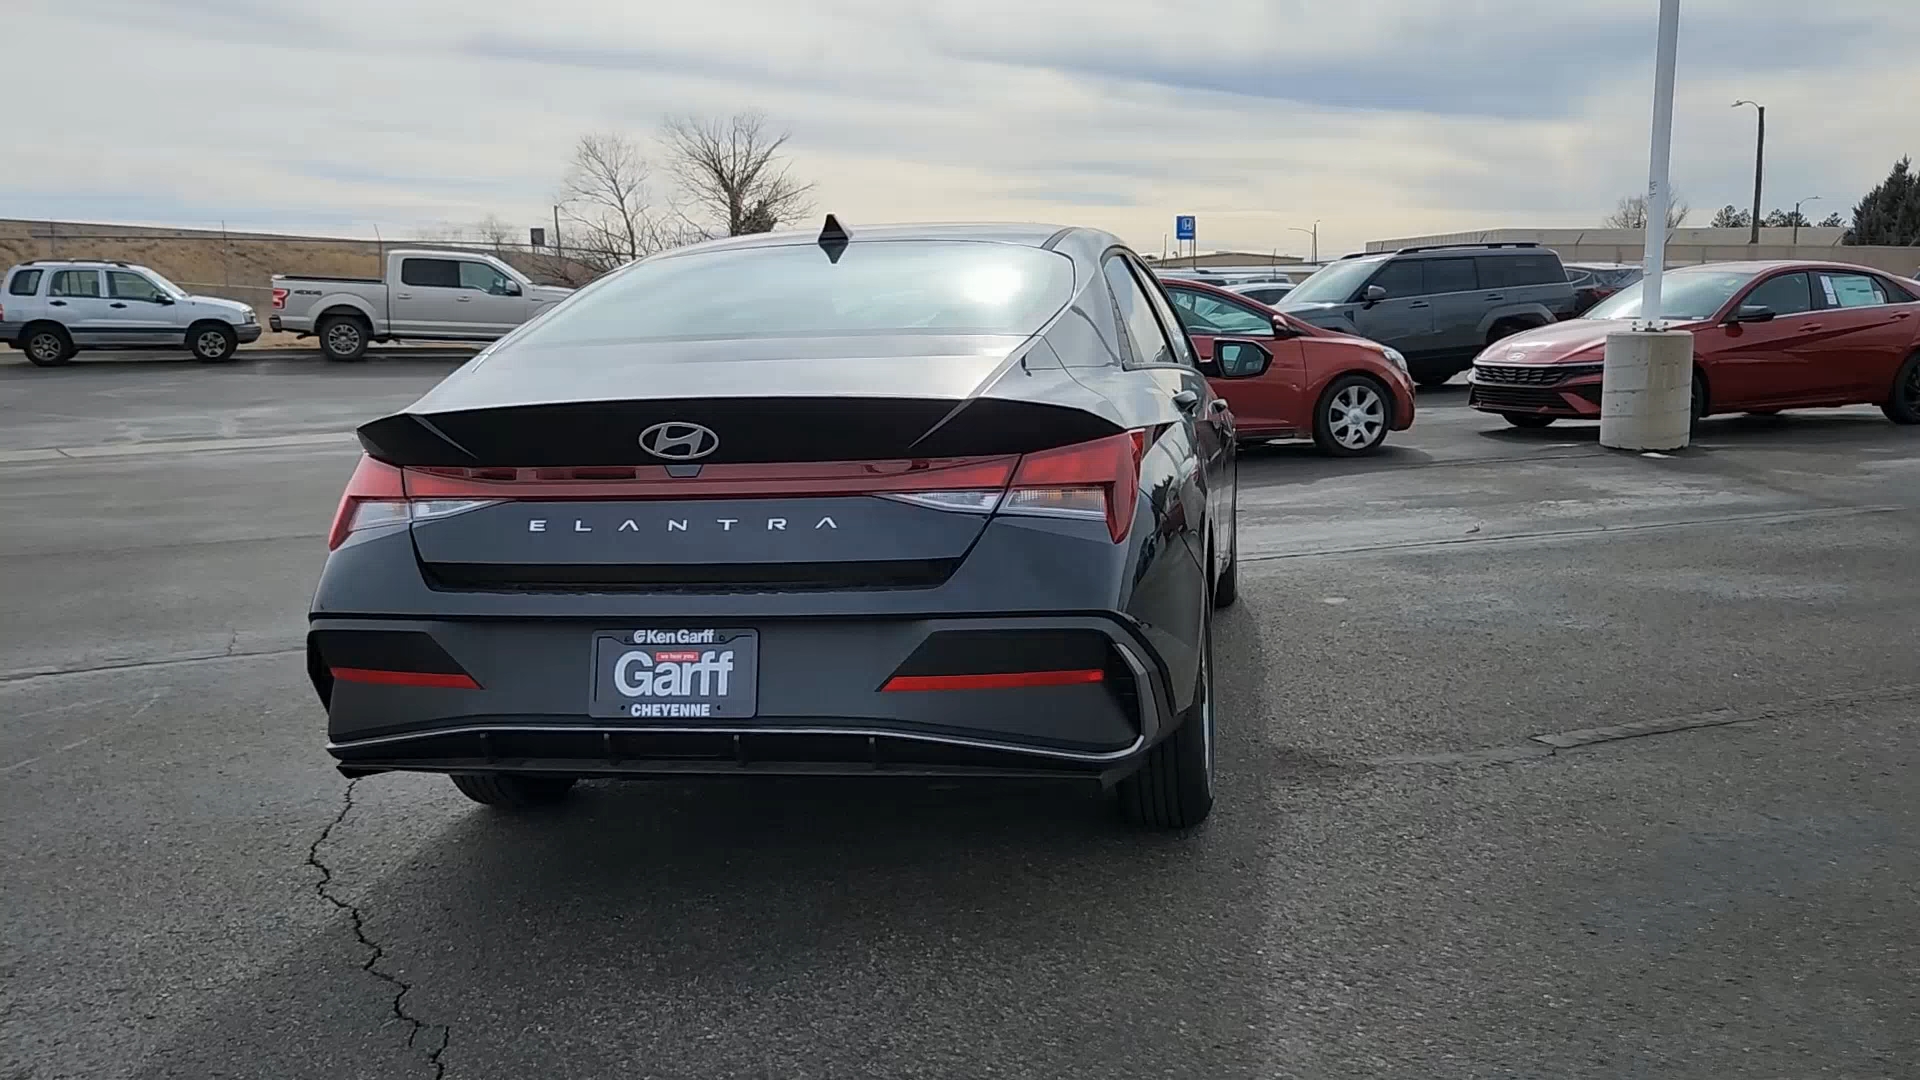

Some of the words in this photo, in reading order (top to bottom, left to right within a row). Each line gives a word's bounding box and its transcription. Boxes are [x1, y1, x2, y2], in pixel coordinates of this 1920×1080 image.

[529, 516, 837, 532] ELANTRA
[647, 629, 676, 644] Ken
[677, 629, 714, 644] Garff
[614, 650, 734, 697] Garff
[630, 703, 711, 717] CHEYENNE
